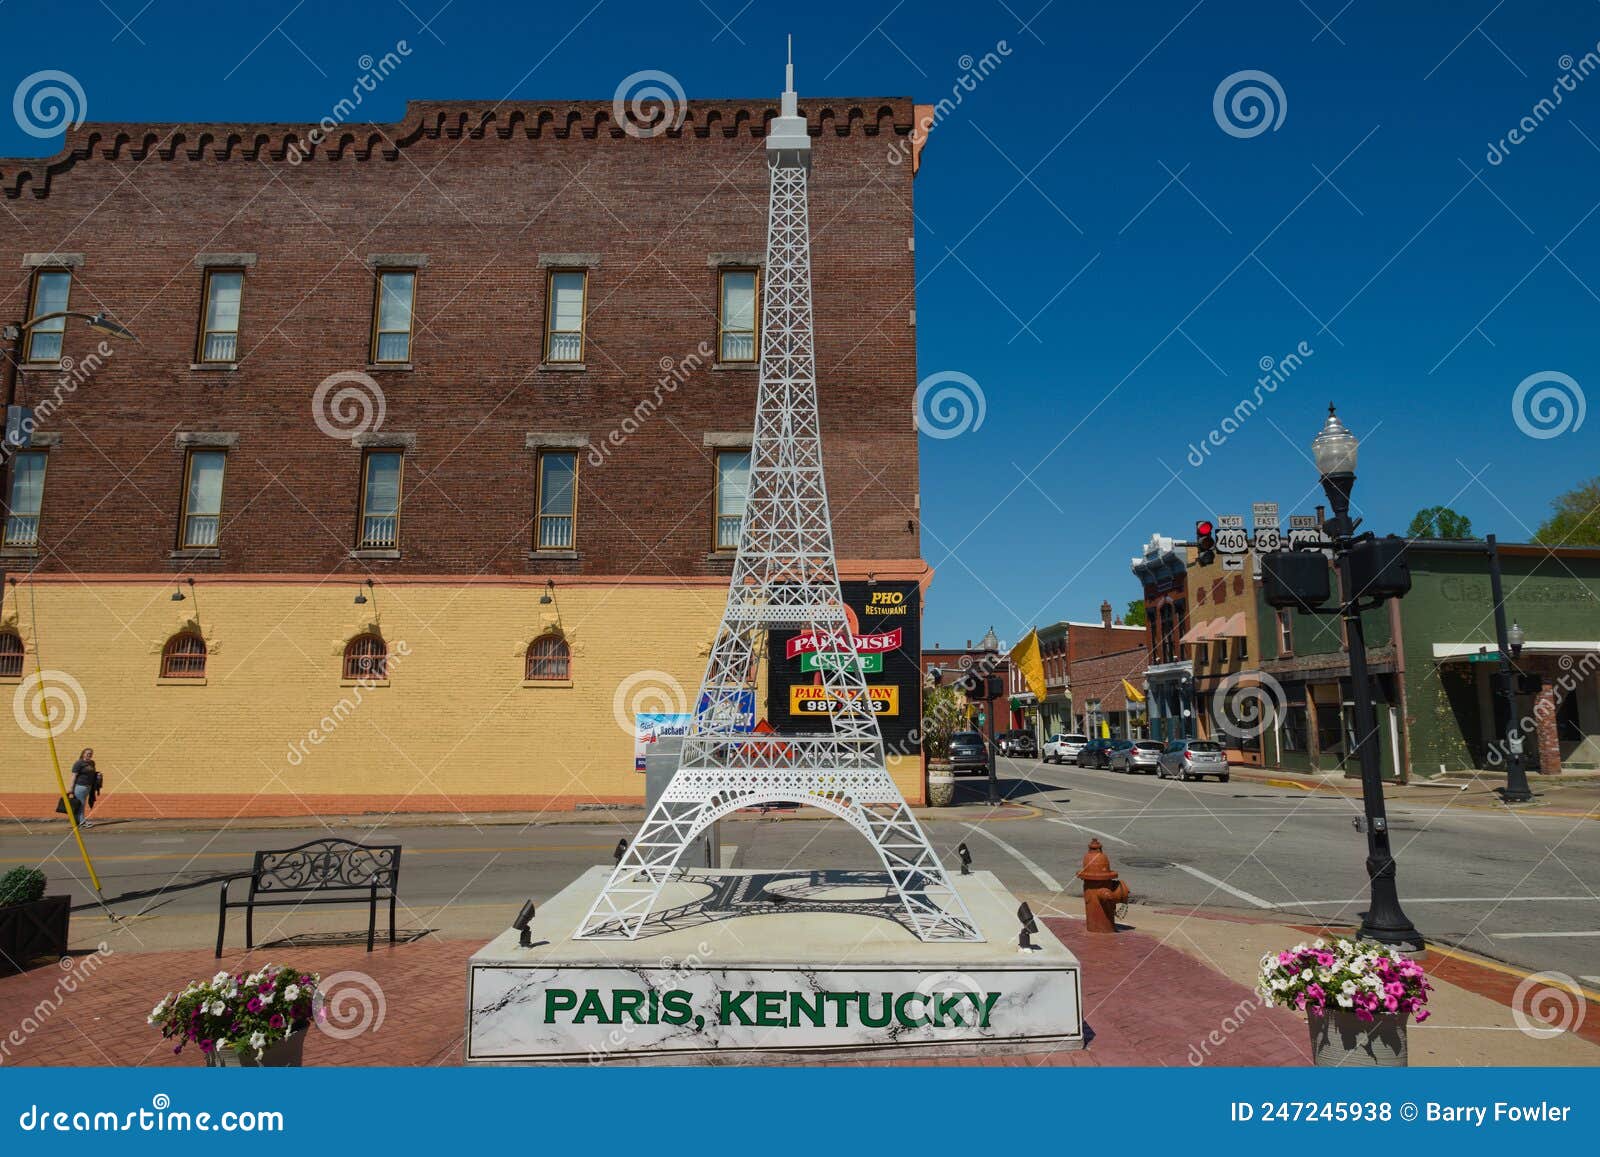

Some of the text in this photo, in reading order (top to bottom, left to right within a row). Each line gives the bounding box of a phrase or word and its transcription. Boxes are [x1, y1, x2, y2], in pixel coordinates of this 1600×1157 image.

[1220, 517, 1240, 526] WEST
[1257, 517, 1276, 526] EAST
[1293, 517, 1312, 526] EAST
[1219, 534, 1244, 548] 460
[1258, 534, 1278, 548] 68
[871, 592, 904, 604] PHO
[865, 605, 908, 615] RESTAURANT
[794, 634, 897, 653] PARADISE
[794, 688, 863, 698] PARDIS
[543, 988, 1003, 1031] PARIS, KENTUCKY
